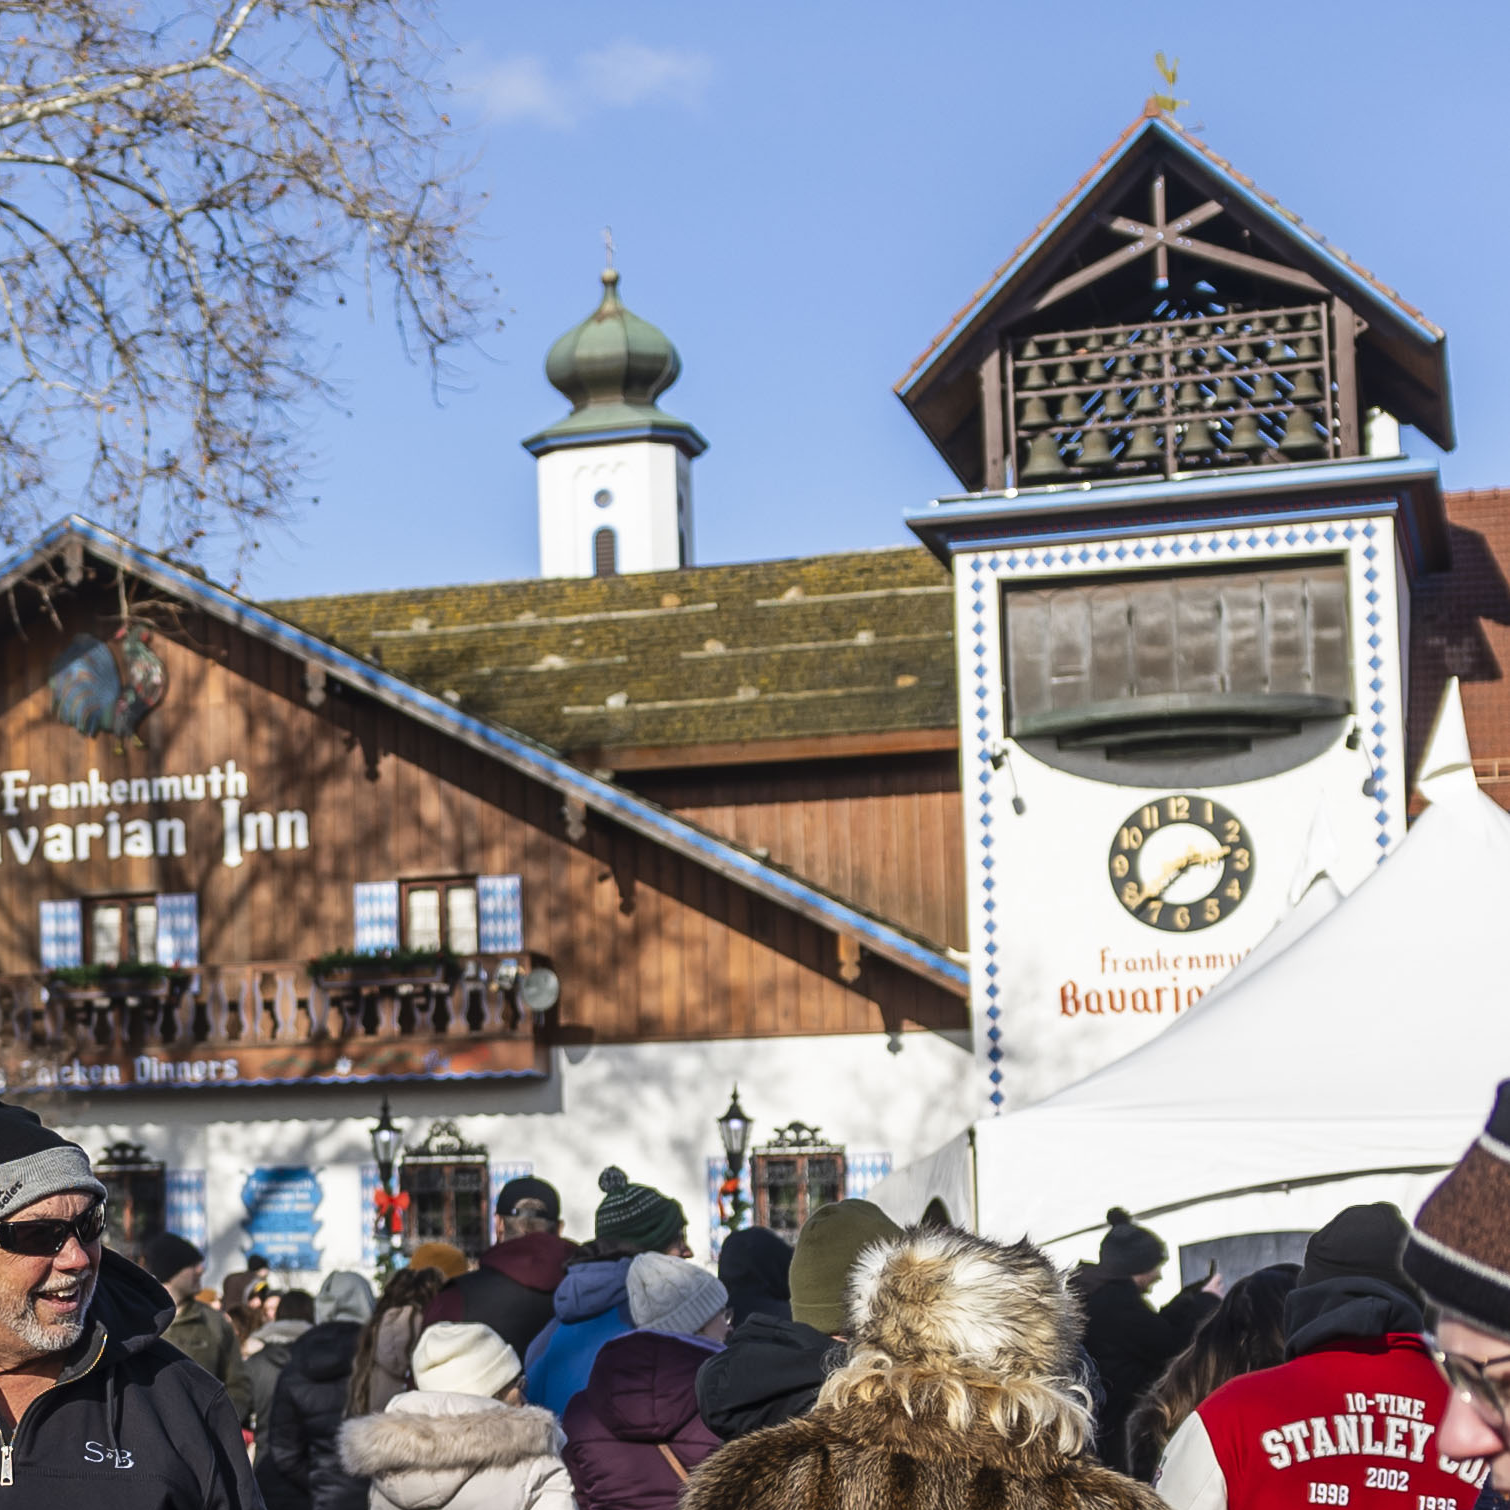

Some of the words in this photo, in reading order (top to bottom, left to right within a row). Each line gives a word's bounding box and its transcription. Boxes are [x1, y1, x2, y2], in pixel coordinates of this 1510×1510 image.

[0, 759, 248, 815] Frankenmuth
[1142, 806, 1159, 829] 11
[1168, 796, 1190, 820] 12
[1204, 801, 1214, 824] 1
[221, 798, 310, 868] Inn
[1120, 826, 1143, 850] 10
[1224, 819, 1241, 843] 2
[1112, 854, 1129, 878] 9
[1232, 848, 1250, 872] 3
[1225, 878, 1242, 901] 4
[1148, 900, 1164, 924] 7
[1174, 906, 1191, 930] 6
[1204, 898, 1221, 923] 5
[1100, 947, 1251, 974] Frankenmu
[1060, 977, 1215, 1018] Bavaria
[134, 1054, 239, 1083] Dinners
[1345, 1392, 1426, 1420] 10-TIME
[1261, 1414, 1435, 1470] STANLEY
[1366, 1467, 1409, 1492] 2002
[1308, 1482, 1350, 1506] 1998
